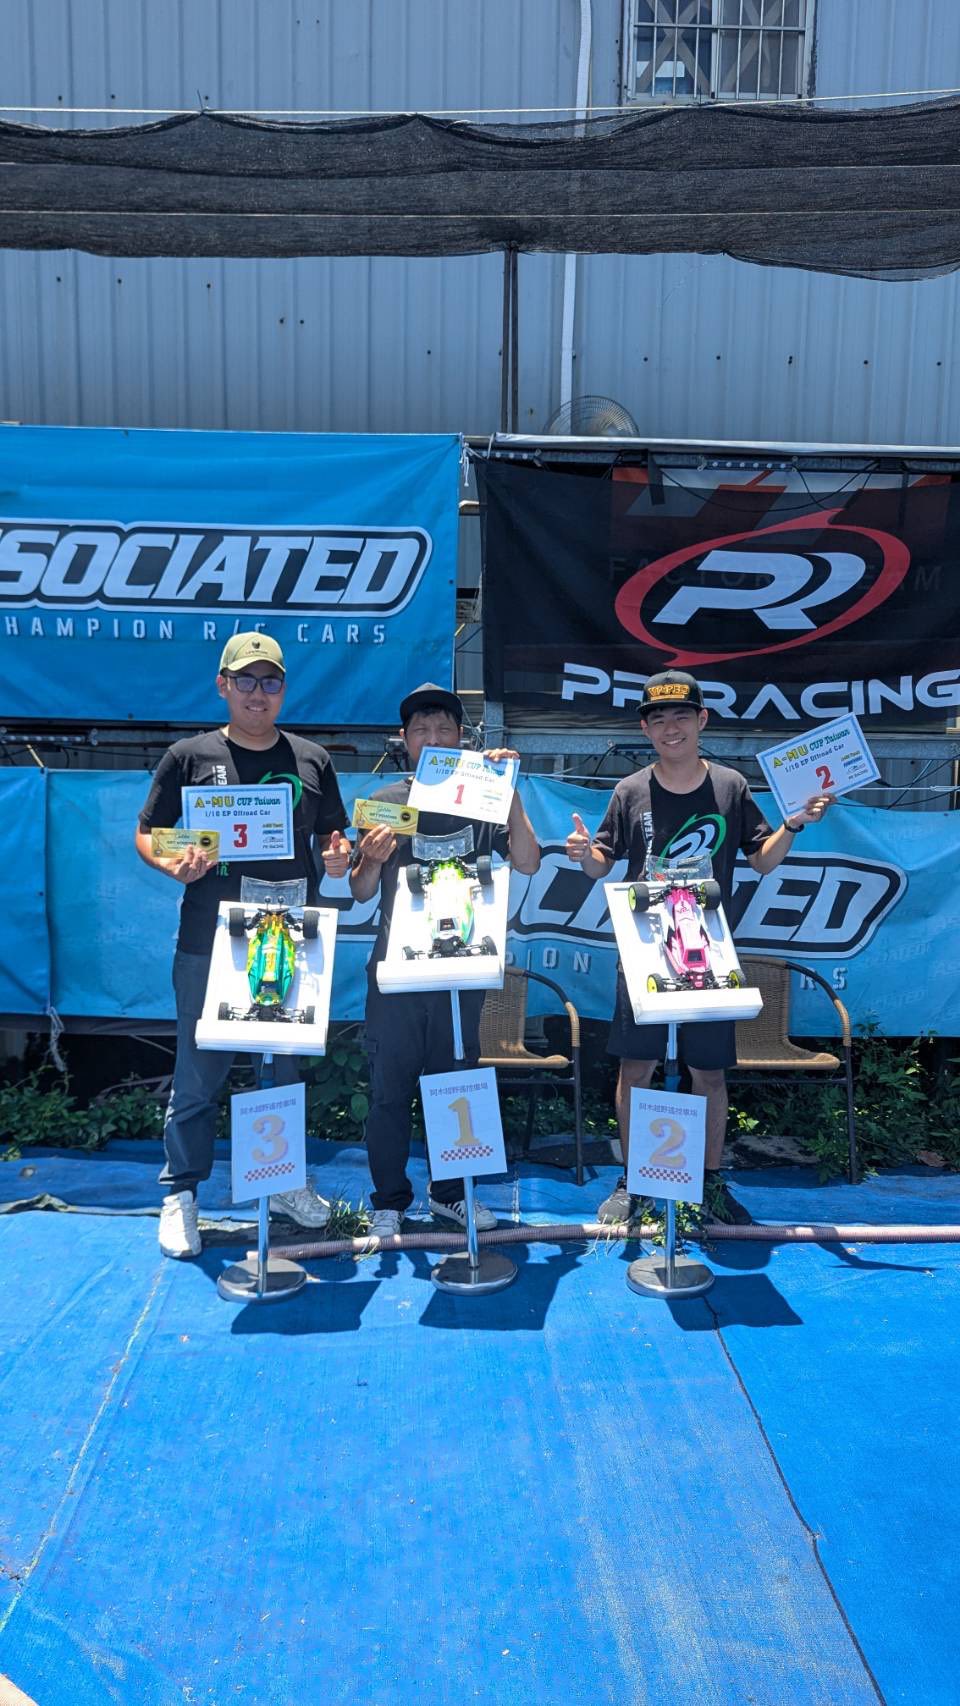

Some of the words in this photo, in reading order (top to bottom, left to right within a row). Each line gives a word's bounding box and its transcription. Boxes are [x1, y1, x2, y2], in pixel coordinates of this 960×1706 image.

[0, 529, 420, 604] SOCIATED
[297, 623, 387, 645] CARS
[773, 744, 809, 769] A-MU
[809, 738, 824, 752] CUP
[824, 727, 851, 746] Taiwan
[215, 764, 228, 786] EAM
[815, 765, 835, 790] 2
[194, 796, 236, 809] A-MU
[236, 797, 253, 806] CUP
[254, 796, 281, 806] Taiwan
[454, 783, 465, 805] 1
[233, 823, 248, 848] 3
[643, 811, 654, 840] TEAM
[447, 1096, 483, 1147] 1
[251, 1114, 290, 1165] 3
[649, 1117, 688, 1169] 2
